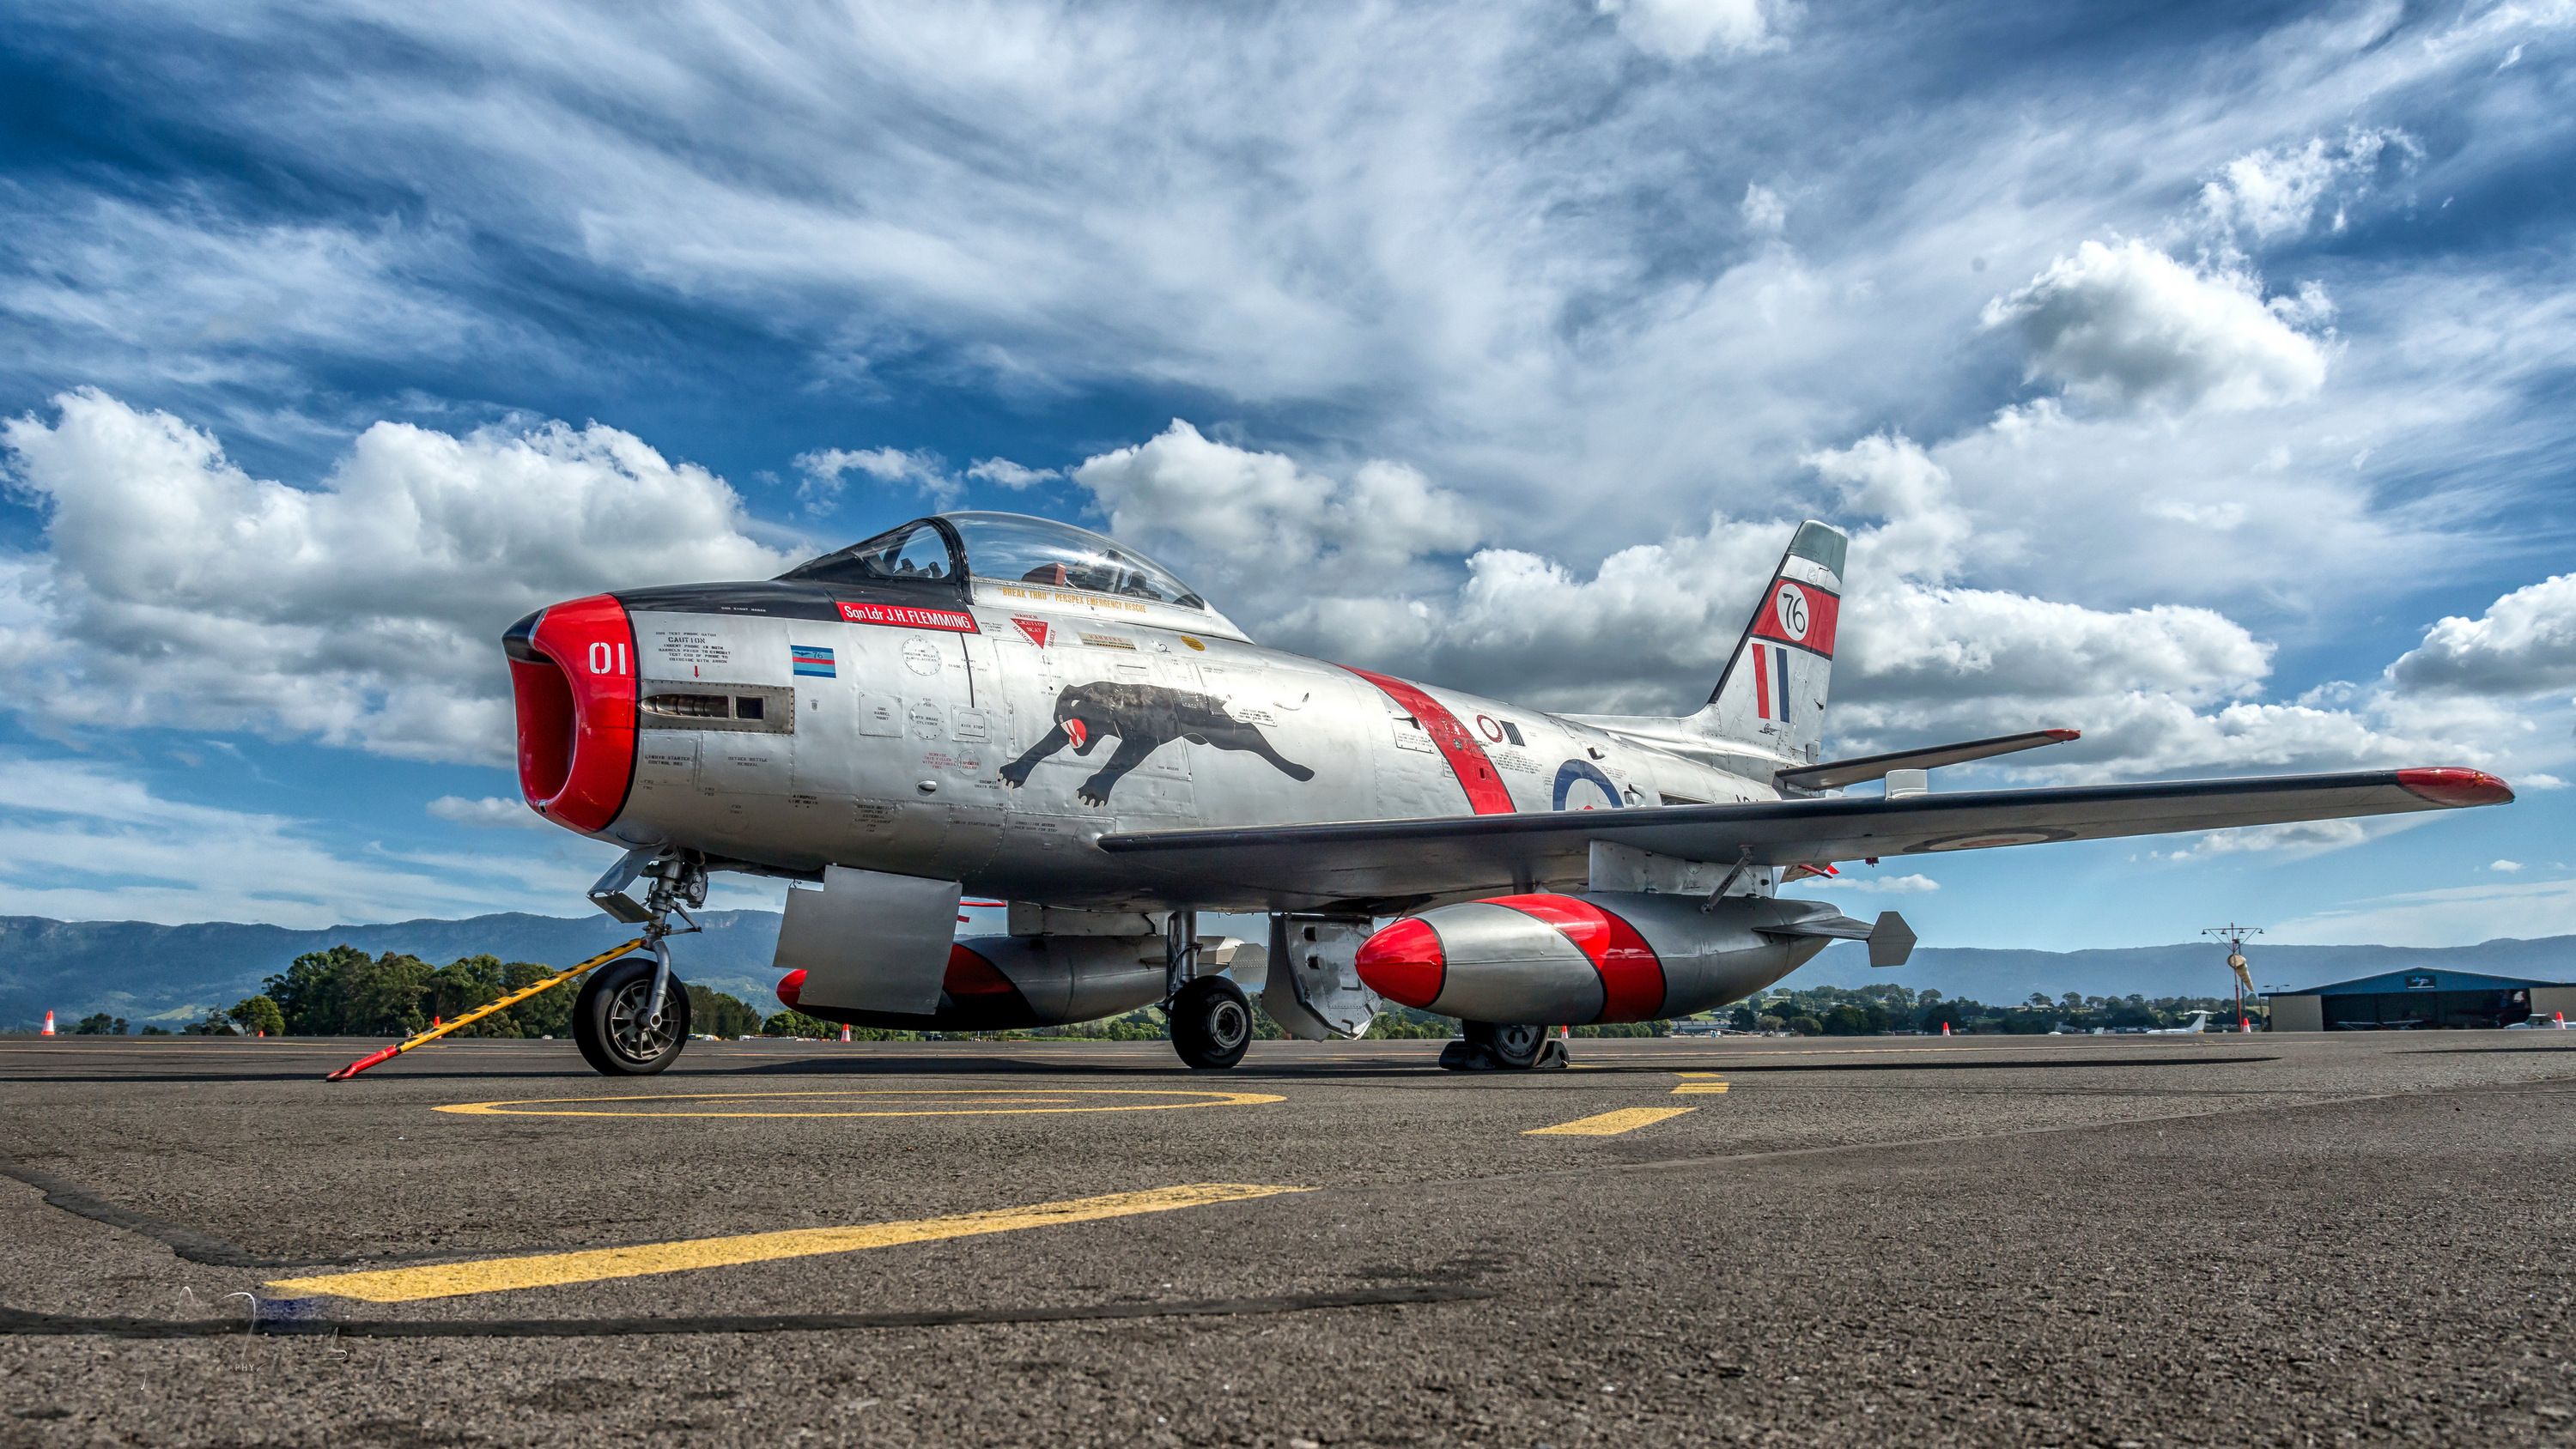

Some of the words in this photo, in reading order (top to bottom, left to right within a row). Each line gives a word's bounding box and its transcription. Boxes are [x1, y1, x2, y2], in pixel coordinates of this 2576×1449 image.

[1054, 592, 1084, 604] PERSPEX
[1086, 597, 1123, 610] EMERGENCY
[1124, 602, 1146, 613] RESCUE
[1783, 592, 1806, 634] 76
[844, 605, 866, 620] Sqn
[865, 606, 884, 620] Ldr
[907, 609, 971, 629] FLEMMING
[1012, 626, 1035, 647] DANGER
[589, 642, 626, 675] 01
